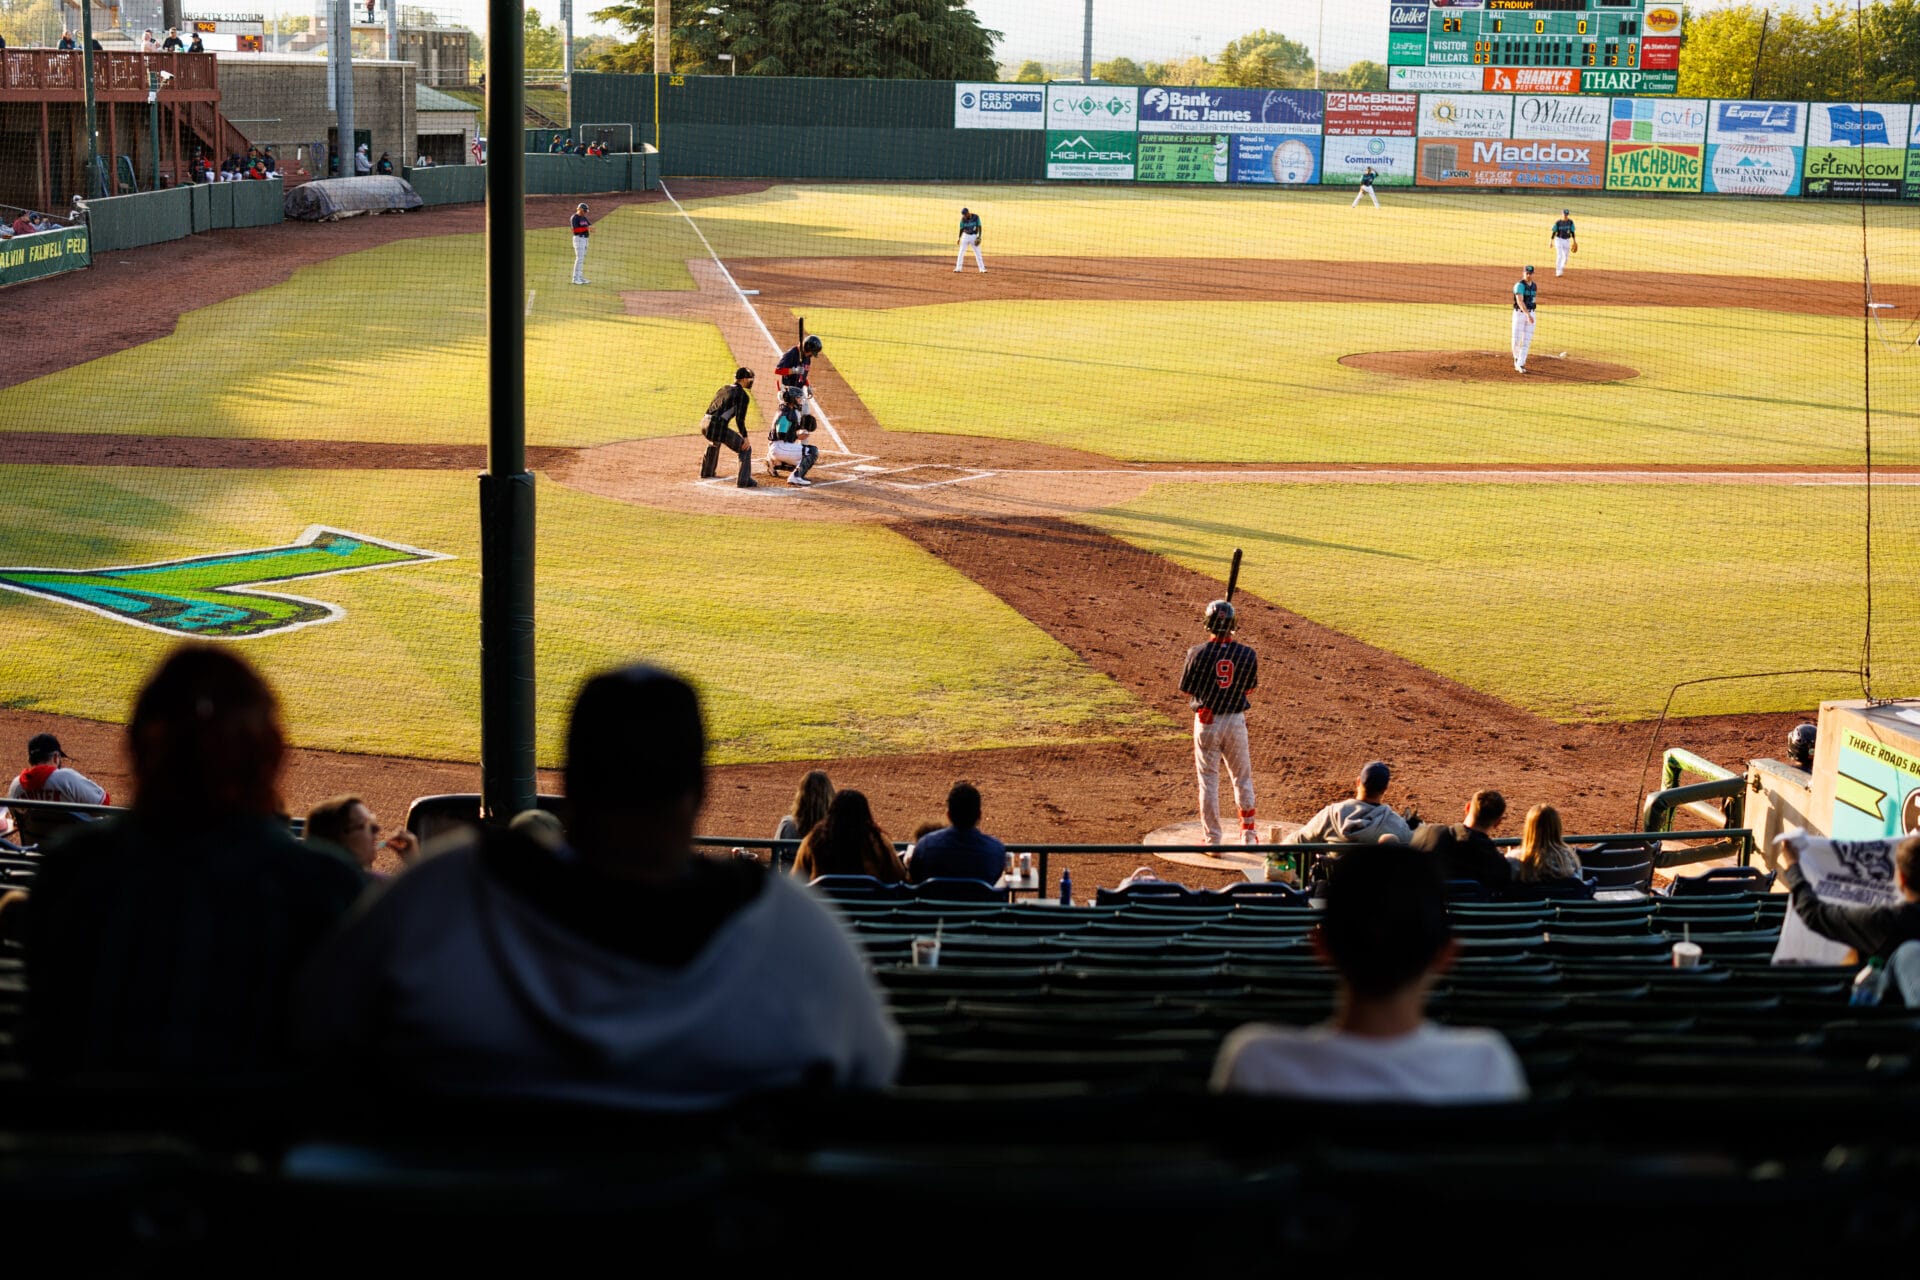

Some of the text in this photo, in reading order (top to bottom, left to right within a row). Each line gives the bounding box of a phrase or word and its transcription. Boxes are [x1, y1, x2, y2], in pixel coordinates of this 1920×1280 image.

[1490, 0, 1534, 9] STADIUM
[202, 12, 222, 20] CITY
[225, 13, 264, 21] STADIUM
[1452, 10, 1464, 18] BAT
[1489, 11, 1506, 19] BALL
[1528, 12, 1552, 20] STRIKE
[1443, 18, 1462, 32] 27
[1535, 19, 1544, 33] 0
[1578, 20, 1587, 34] 0
[1433, 41, 1467, 50] VISITOR
[1475, 41, 1482, 52] 0
[1484, 41, 1490, 52] 0
[1430, 53, 1469, 62] HILLCATS
[1474, 54, 1635, 66] 0 3 3 3 0
[1515, 69, 1573, 86] SHARKY'S
[1582, 71, 1642, 90] THARP
[1408, 81, 1463, 89] SENIOR CARE
[981, 92, 1041, 102] CBS SPORTS
[1169, 92, 1211, 107] Bank
[1348, 93, 1417, 104] McBRIDE
[981, 101, 1013, 110] RADIO
[1169, 107, 1251, 122] The James
[1660, 107, 1704, 129] cvfp
[1170, 123, 1197, 131] Official
[1141, 134, 1212, 143] FIREWORKS SHOWS
[1239, 144, 1263, 152] Support
[1472, 141, 1591, 163] Maddox
[1050, 151, 1132, 161] HIGH PEAK
[1344, 155, 1394, 166] Community
[1611, 148, 1699, 175] LYNCHBURG
[1715, 167, 1791, 177] FIRST NATIONAL
[1810, 161, 1899, 176] GFLENVCOM
[1449, 170, 1470, 178] YORK
[1475, 170, 1495, 178] LET'S
[1740, 175, 1766, 183] BANK
[1475, 177, 1513, 185] STARTED!
[1609, 175, 1698, 189] READY MIX
[29, 240, 63, 263] FALWELL
[1215, 659, 1235, 689] 9
[1848, 735, 1877, 756] THREE
[1878, 748, 1909, 770] ROADS
